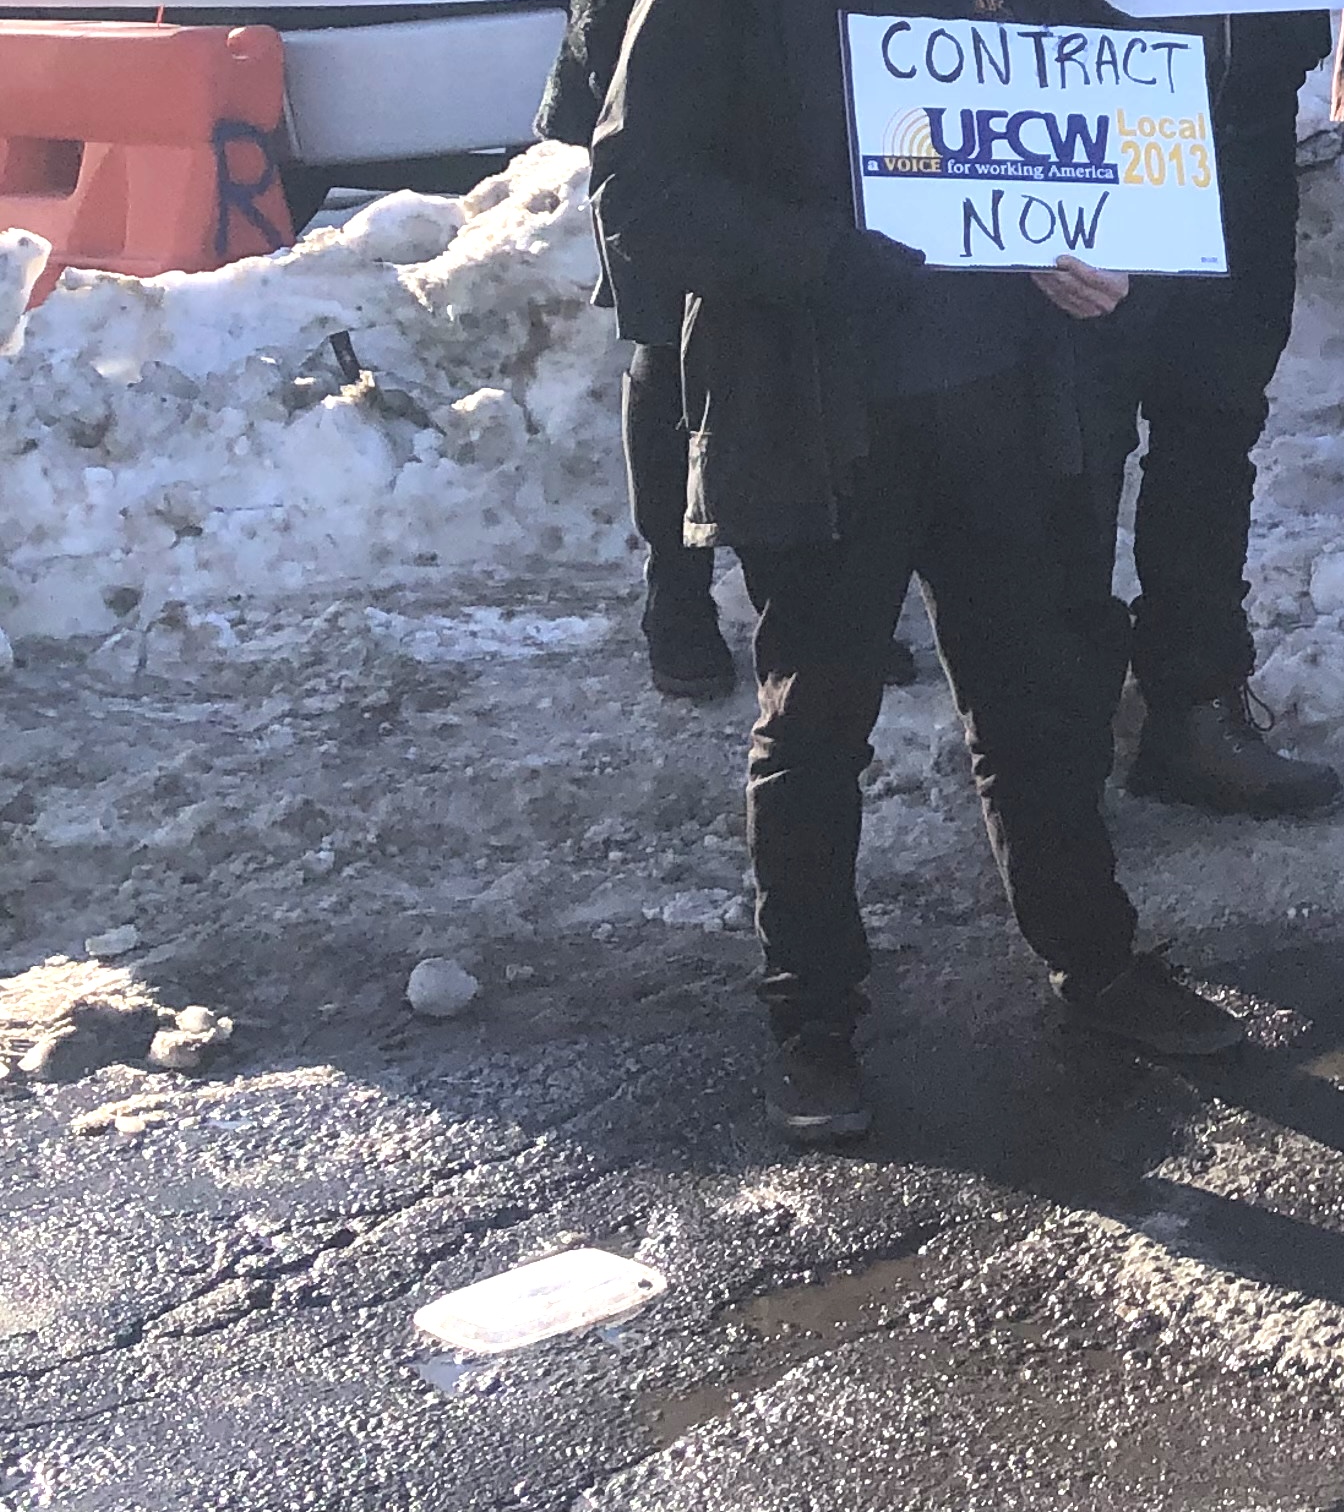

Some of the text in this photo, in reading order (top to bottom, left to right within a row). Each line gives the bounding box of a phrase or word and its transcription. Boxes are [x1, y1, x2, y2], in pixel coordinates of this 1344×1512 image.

[882, 21, 1191, 93] CONTRACT
[922, 107, 1111, 164] UFCW
[1116, 108, 1206, 140] Local
[212, 118, 284, 257] R
[867, 156, 1114, 179] a VOICE for working America
[1121, 141, 1211, 188] 2013
[960, 189, 1110, 257] NOW
